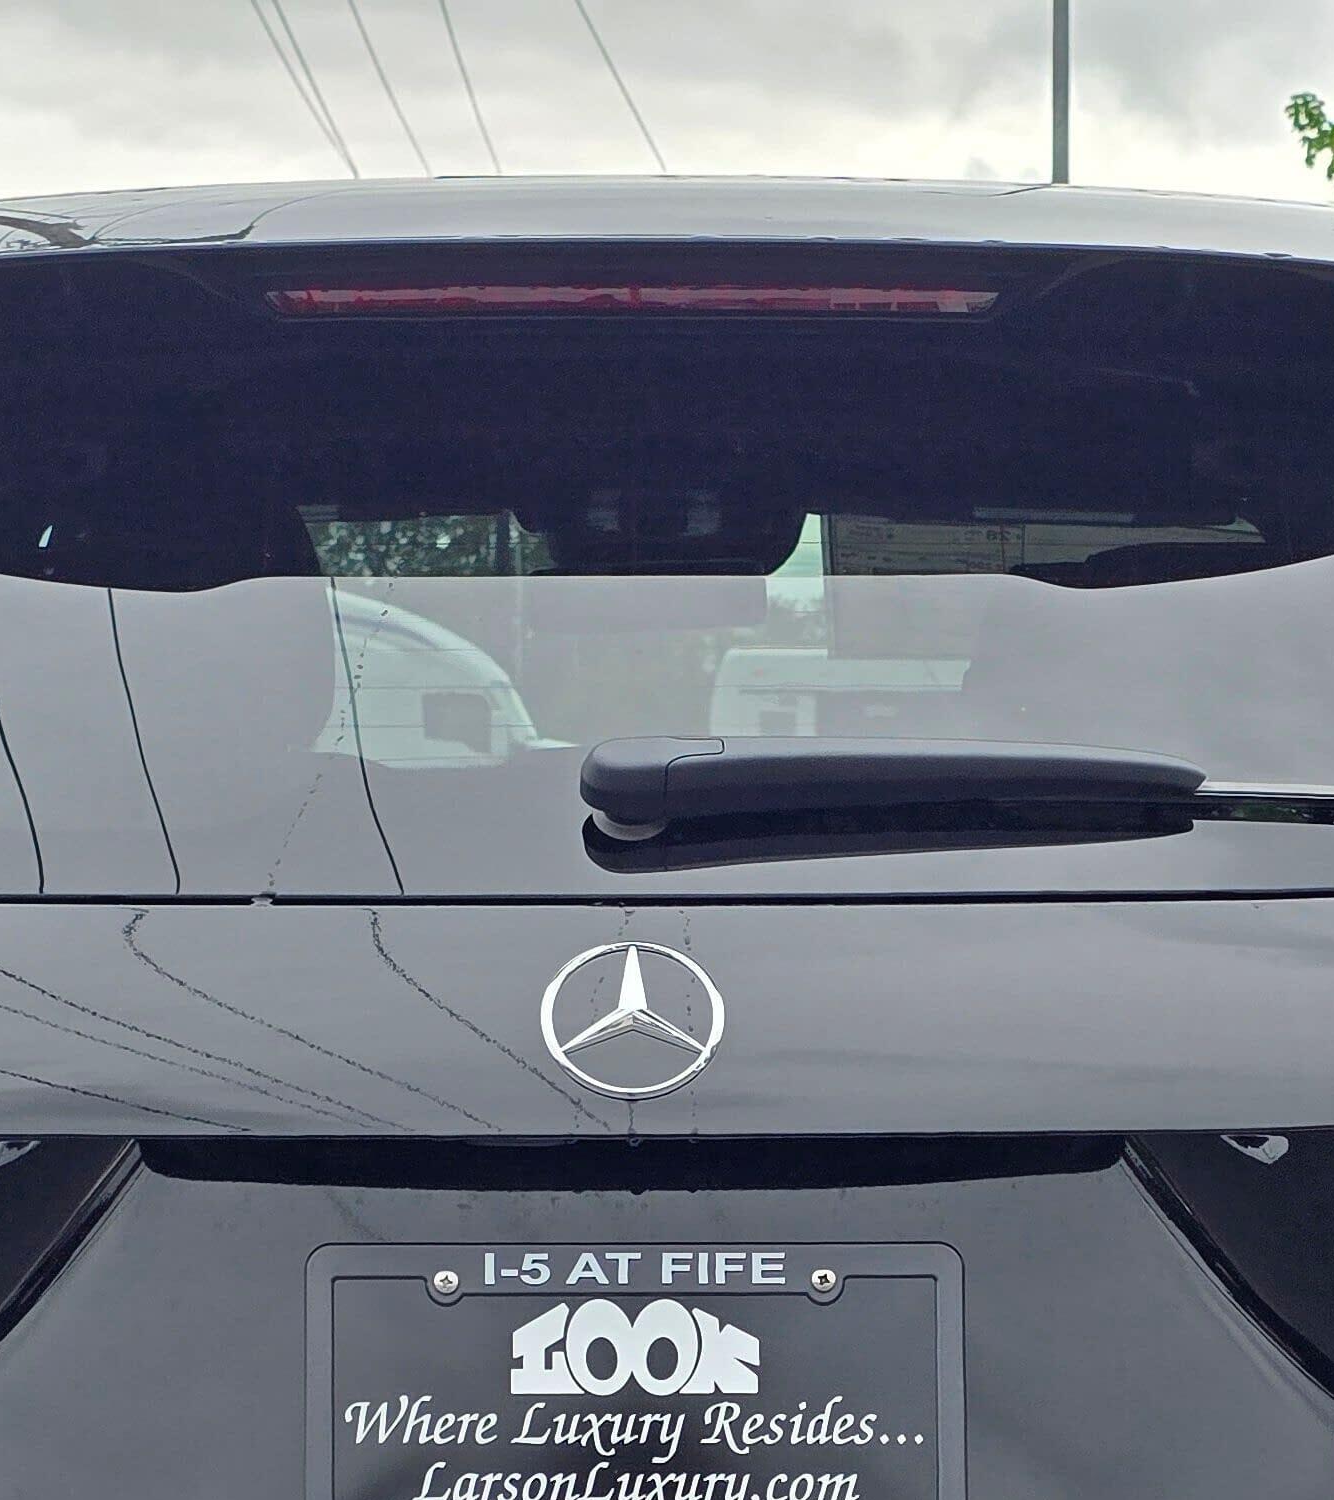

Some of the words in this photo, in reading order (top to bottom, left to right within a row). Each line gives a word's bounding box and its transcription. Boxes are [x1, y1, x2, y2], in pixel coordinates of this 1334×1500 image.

[483, 1252, 551, 1285] I-5
[565, 1252, 642, 1285] AT
[660, 1252, 786, 1285] FIFE
[509, 1298, 761, 1396] LOOK
[343, 1395, 499, 1446] Where
[510, 1400, 687, 1464] Luxury
[699, 1395, 925, 1456] Resides...
